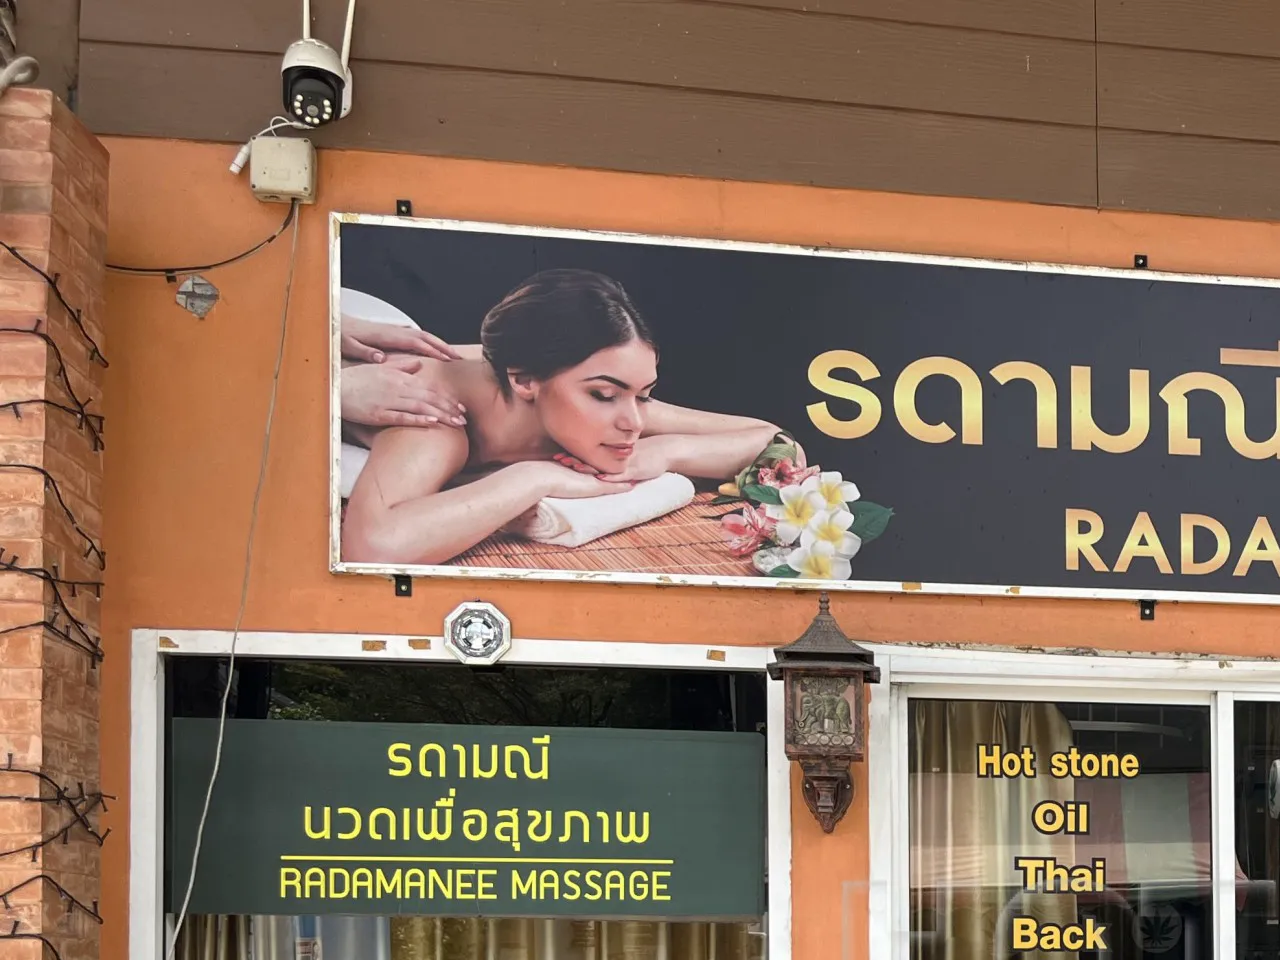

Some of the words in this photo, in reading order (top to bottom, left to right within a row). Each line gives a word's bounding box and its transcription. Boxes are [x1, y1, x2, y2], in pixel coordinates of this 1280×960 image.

[388, 735, 550, 780] รดามณี
[977, 743, 1037, 778] Hot
[1050, 747, 1141, 779] stone
[303, 788, 650, 852] นวดเพื่อสุขภาพ
[1032, 800, 1090, 834] Oil
[280, 867, 498, 900] RADAMANEE
[512, 870, 672, 901] MASSAGE
[1017, 857, 1106, 893] Thai
[1012, 917, 1107, 952] Back
